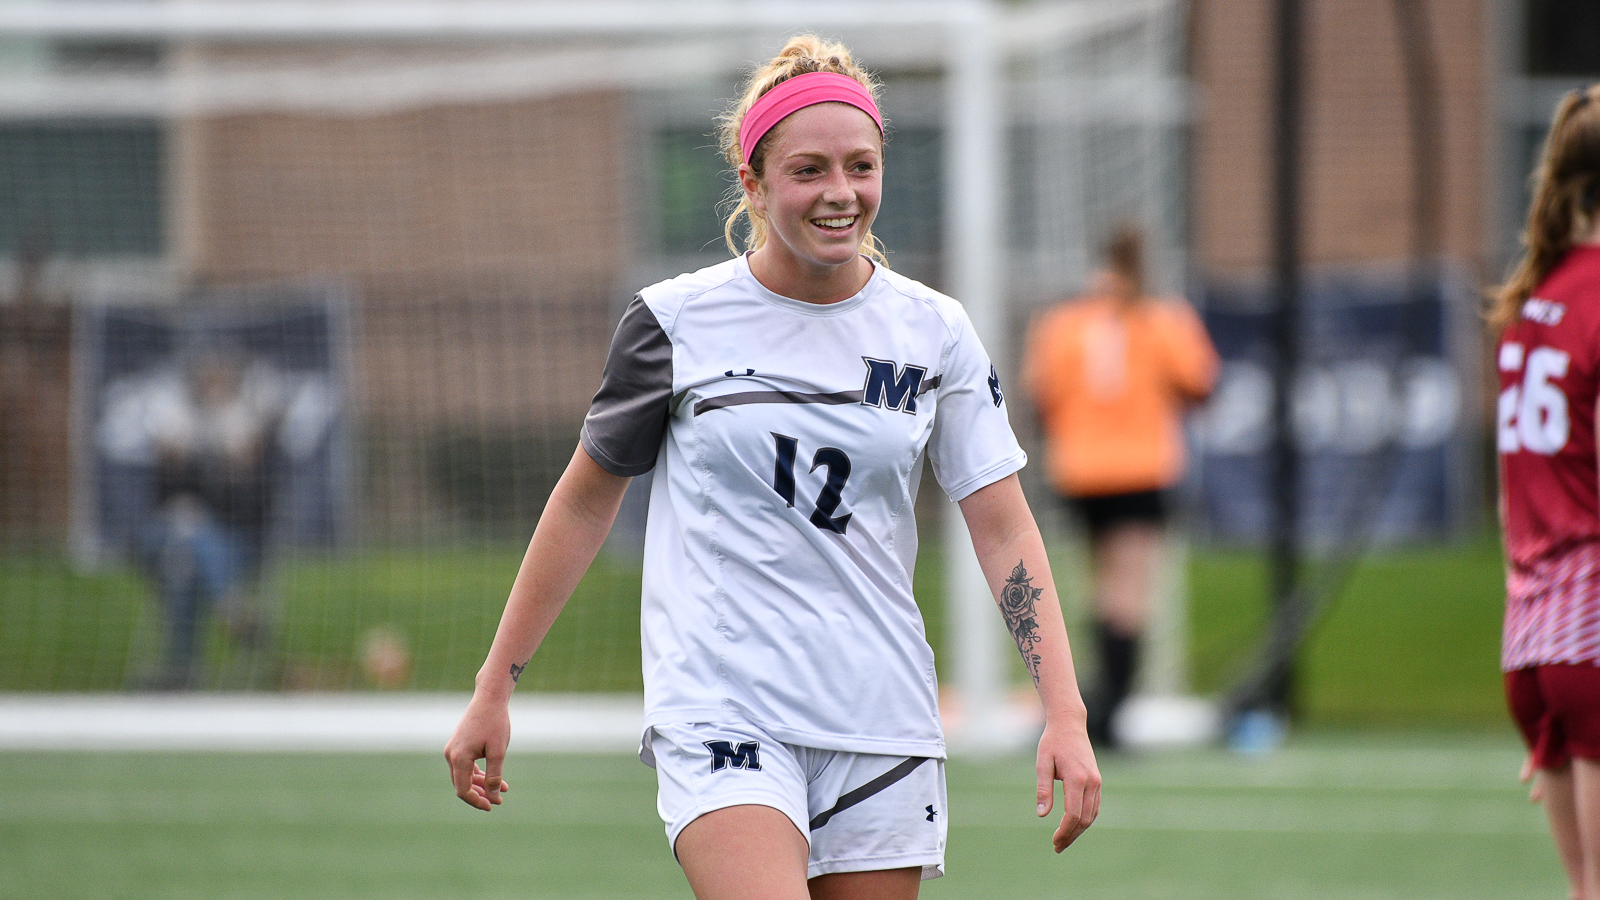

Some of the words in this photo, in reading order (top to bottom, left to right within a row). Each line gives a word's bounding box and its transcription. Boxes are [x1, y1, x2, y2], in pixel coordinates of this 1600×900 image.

[861, 356, 928, 415] M
[770, 431, 853, 535] 12
[702, 739, 762, 774] M
